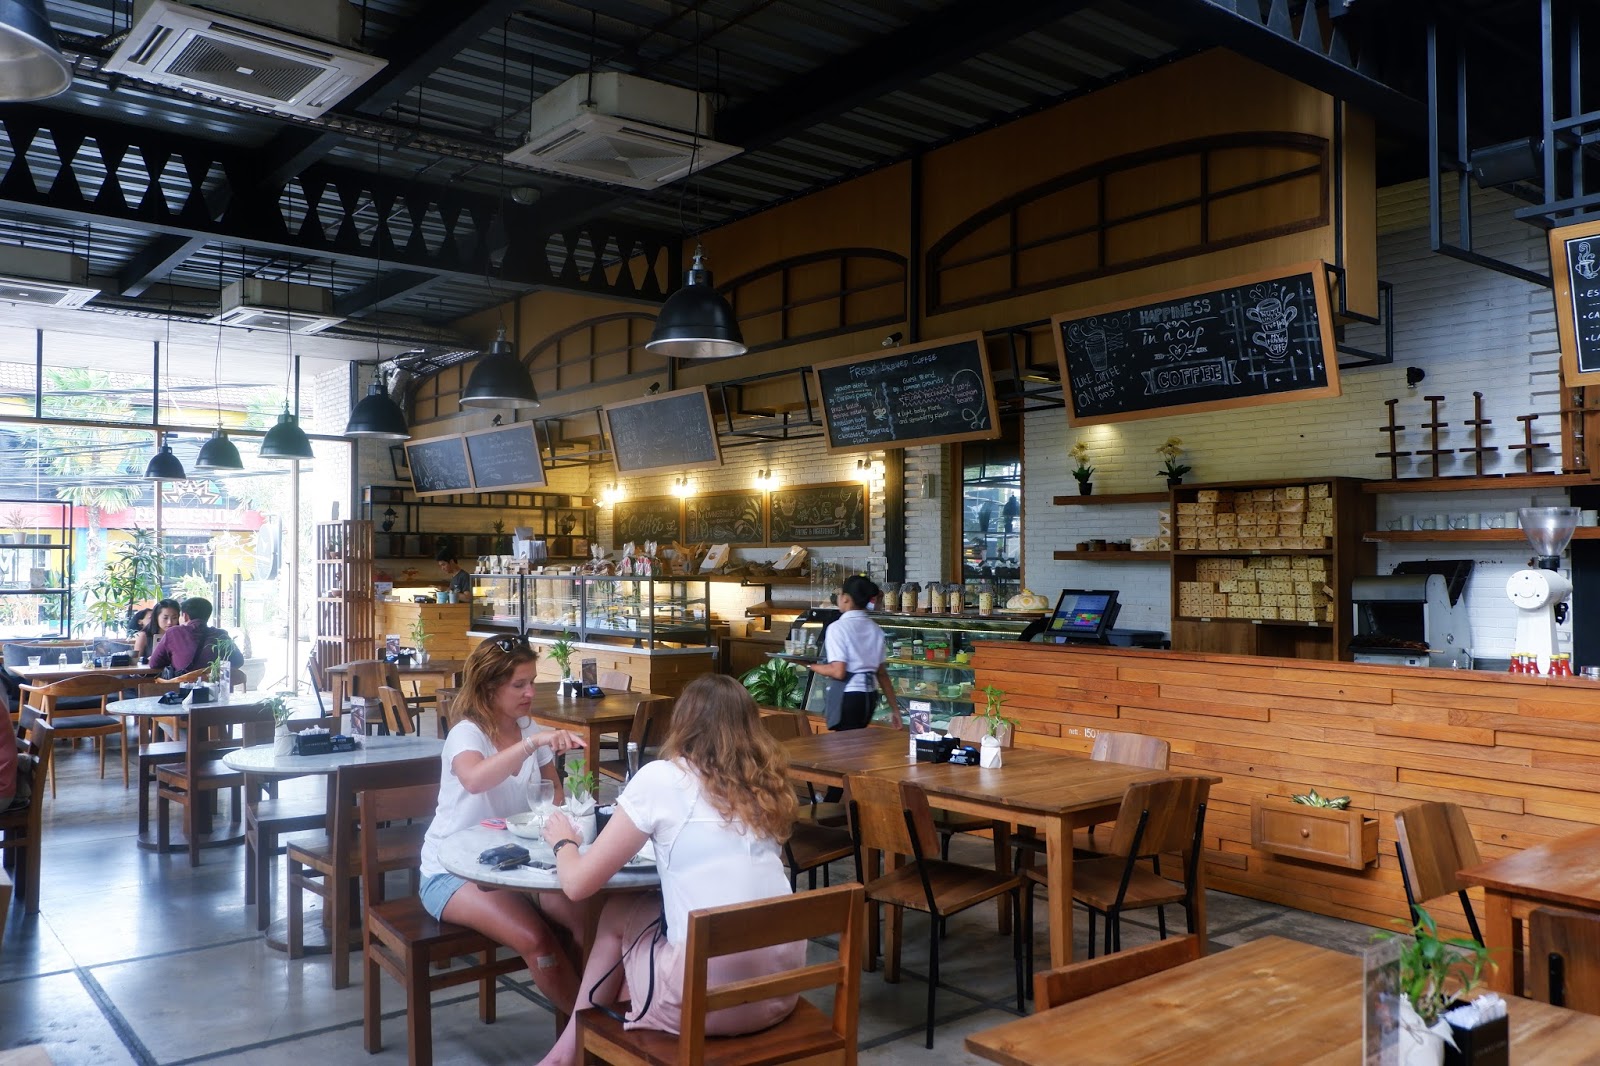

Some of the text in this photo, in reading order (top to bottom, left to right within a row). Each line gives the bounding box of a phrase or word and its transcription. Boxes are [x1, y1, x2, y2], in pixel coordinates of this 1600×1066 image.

[1139, 298, 1212, 325] HAPPINESS
[1142, 326, 1205, 348] in a cup
[849, 353, 938, 380] FRESH BREWED COFFEE
[1076, 372, 1094, 388] LIKE
[1095, 365, 1121, 384] COFFEE
[1157, 363, 1223, 389] COFFEE
[1078, 380, 1114, 408] ON RAINY
[1098, 387, 1116, 400] DAYS
[628, 514, 664, 536] Coffee
[1084, 728, 1096, 738] 150
